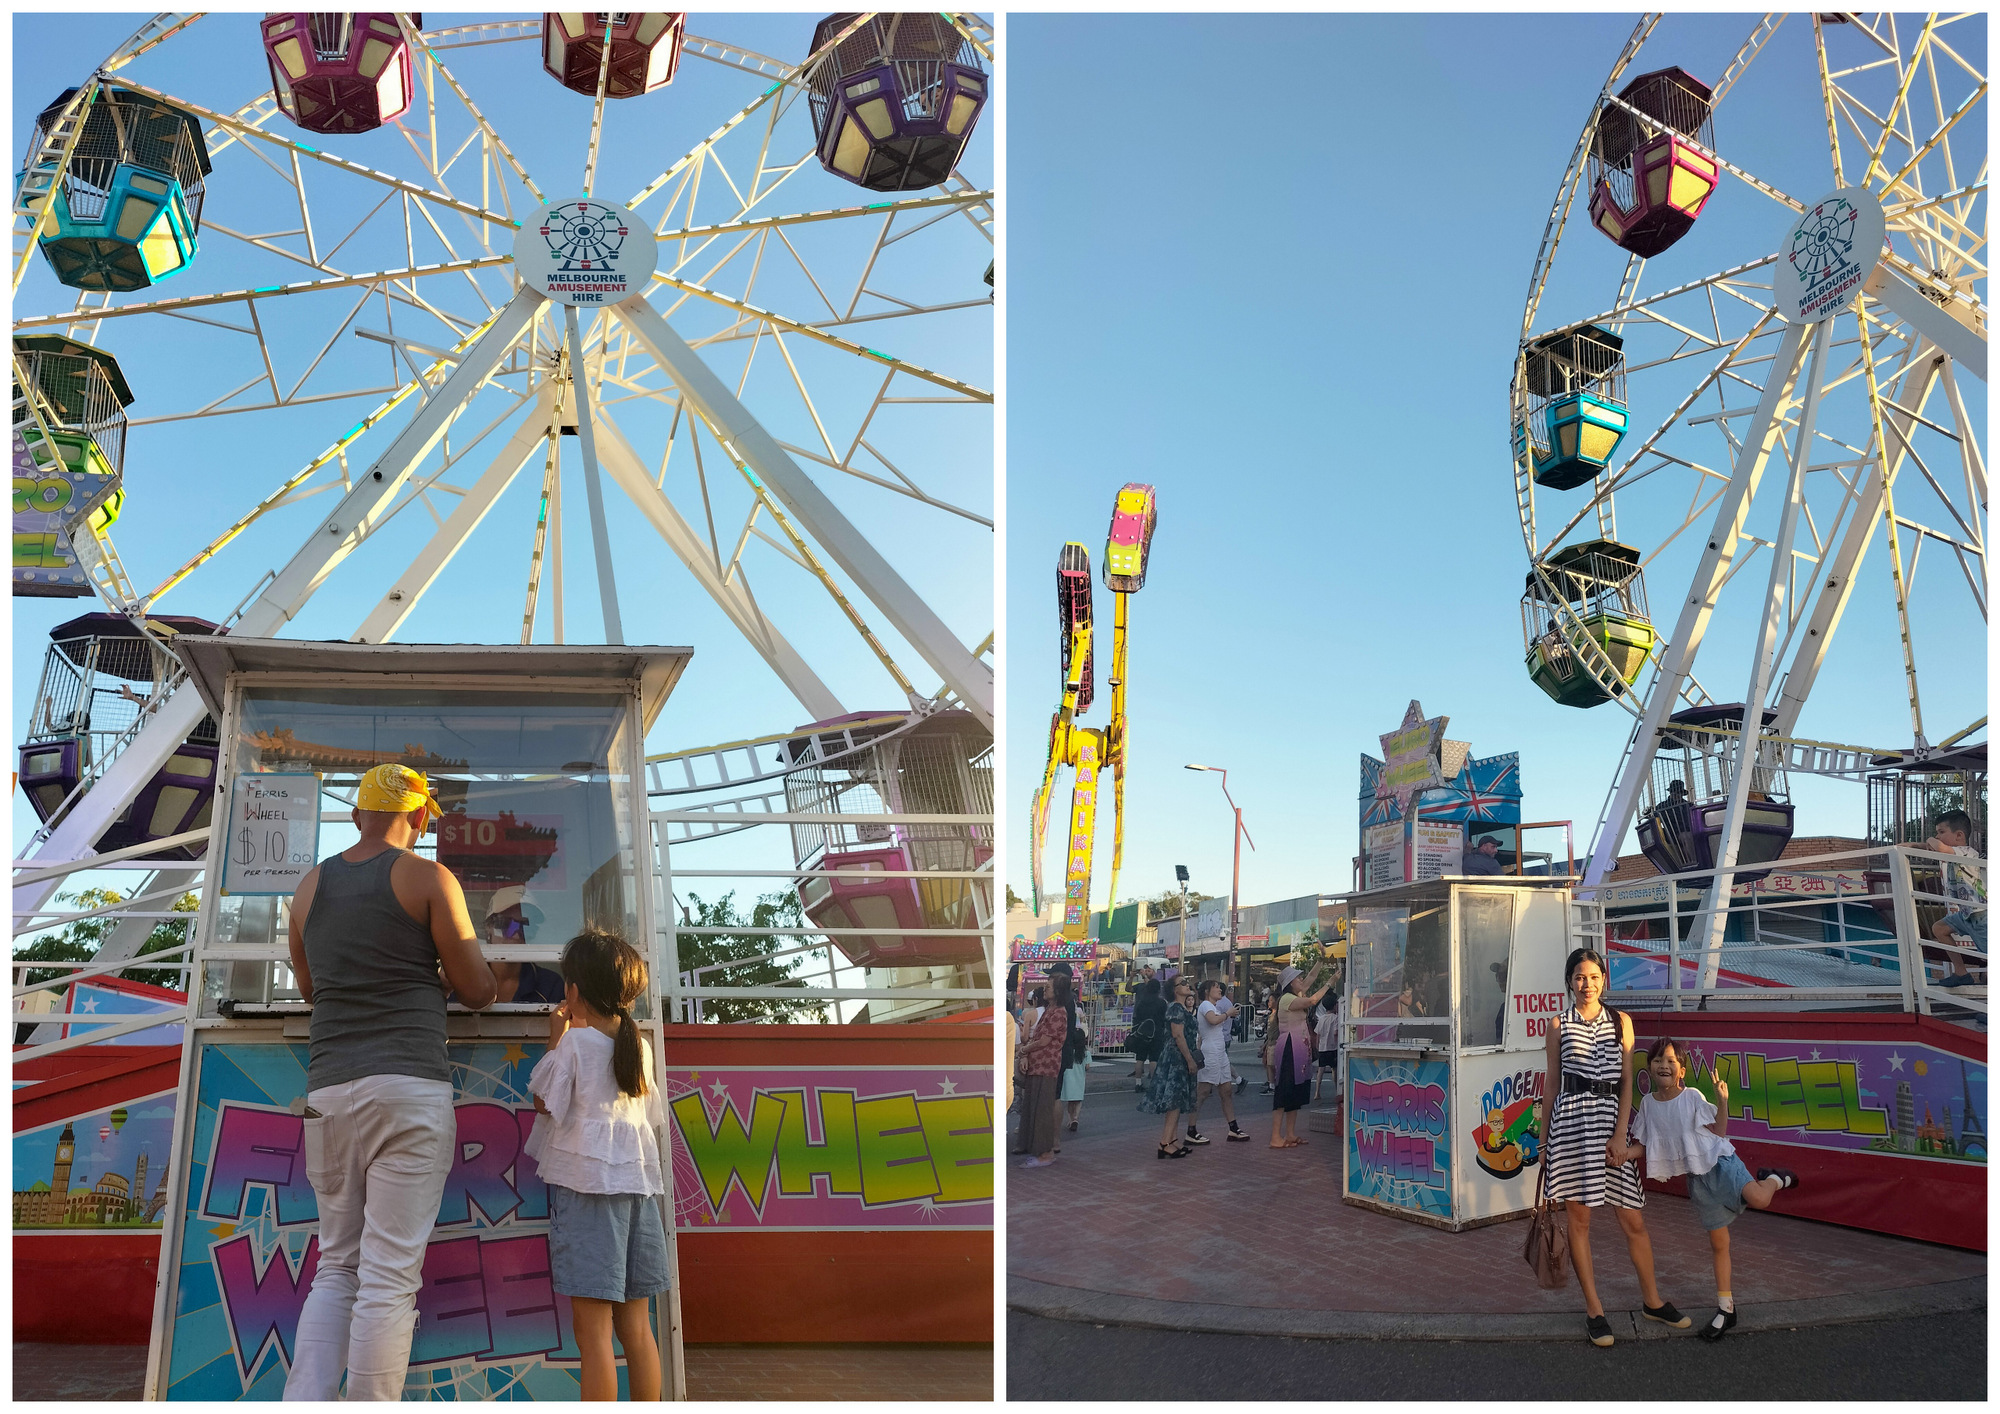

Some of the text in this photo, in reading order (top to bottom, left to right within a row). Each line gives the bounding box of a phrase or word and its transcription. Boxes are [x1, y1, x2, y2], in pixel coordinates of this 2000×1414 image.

[547, 274, 627, 283] MELBOURNE
[547, 283, 627, 292] AMUSEMENT
[1798, 262, 1862, 309] MELBOURNE
[572, 293, 604, 302] HIRE
[1800, 272, 1862, 318] AMUSEMENT
[1819, 294, 1845, 316] HIRE
[1389, 725, 1431, 759] EURO
[1385, 757, 1432, 788] WHEEL
[245, 779, 289, 799] FERRIS
[244, 801, 289, 821] WHEEL
[445, 820, 497, 846] $10
[1066, 745, 1096, 926] KAMIKAZE
[243, 868, 301, 877] PER PERSON
[1513, 992, 1566, 1014] TICKET
[1525, 1017, 1548, 1038] BO
[1353, 1080, 1446, 1137] FERRIS
[668, 1088, 994, 1222] WHEE
[1356, 1128, 1445, 1190] WHEEL
